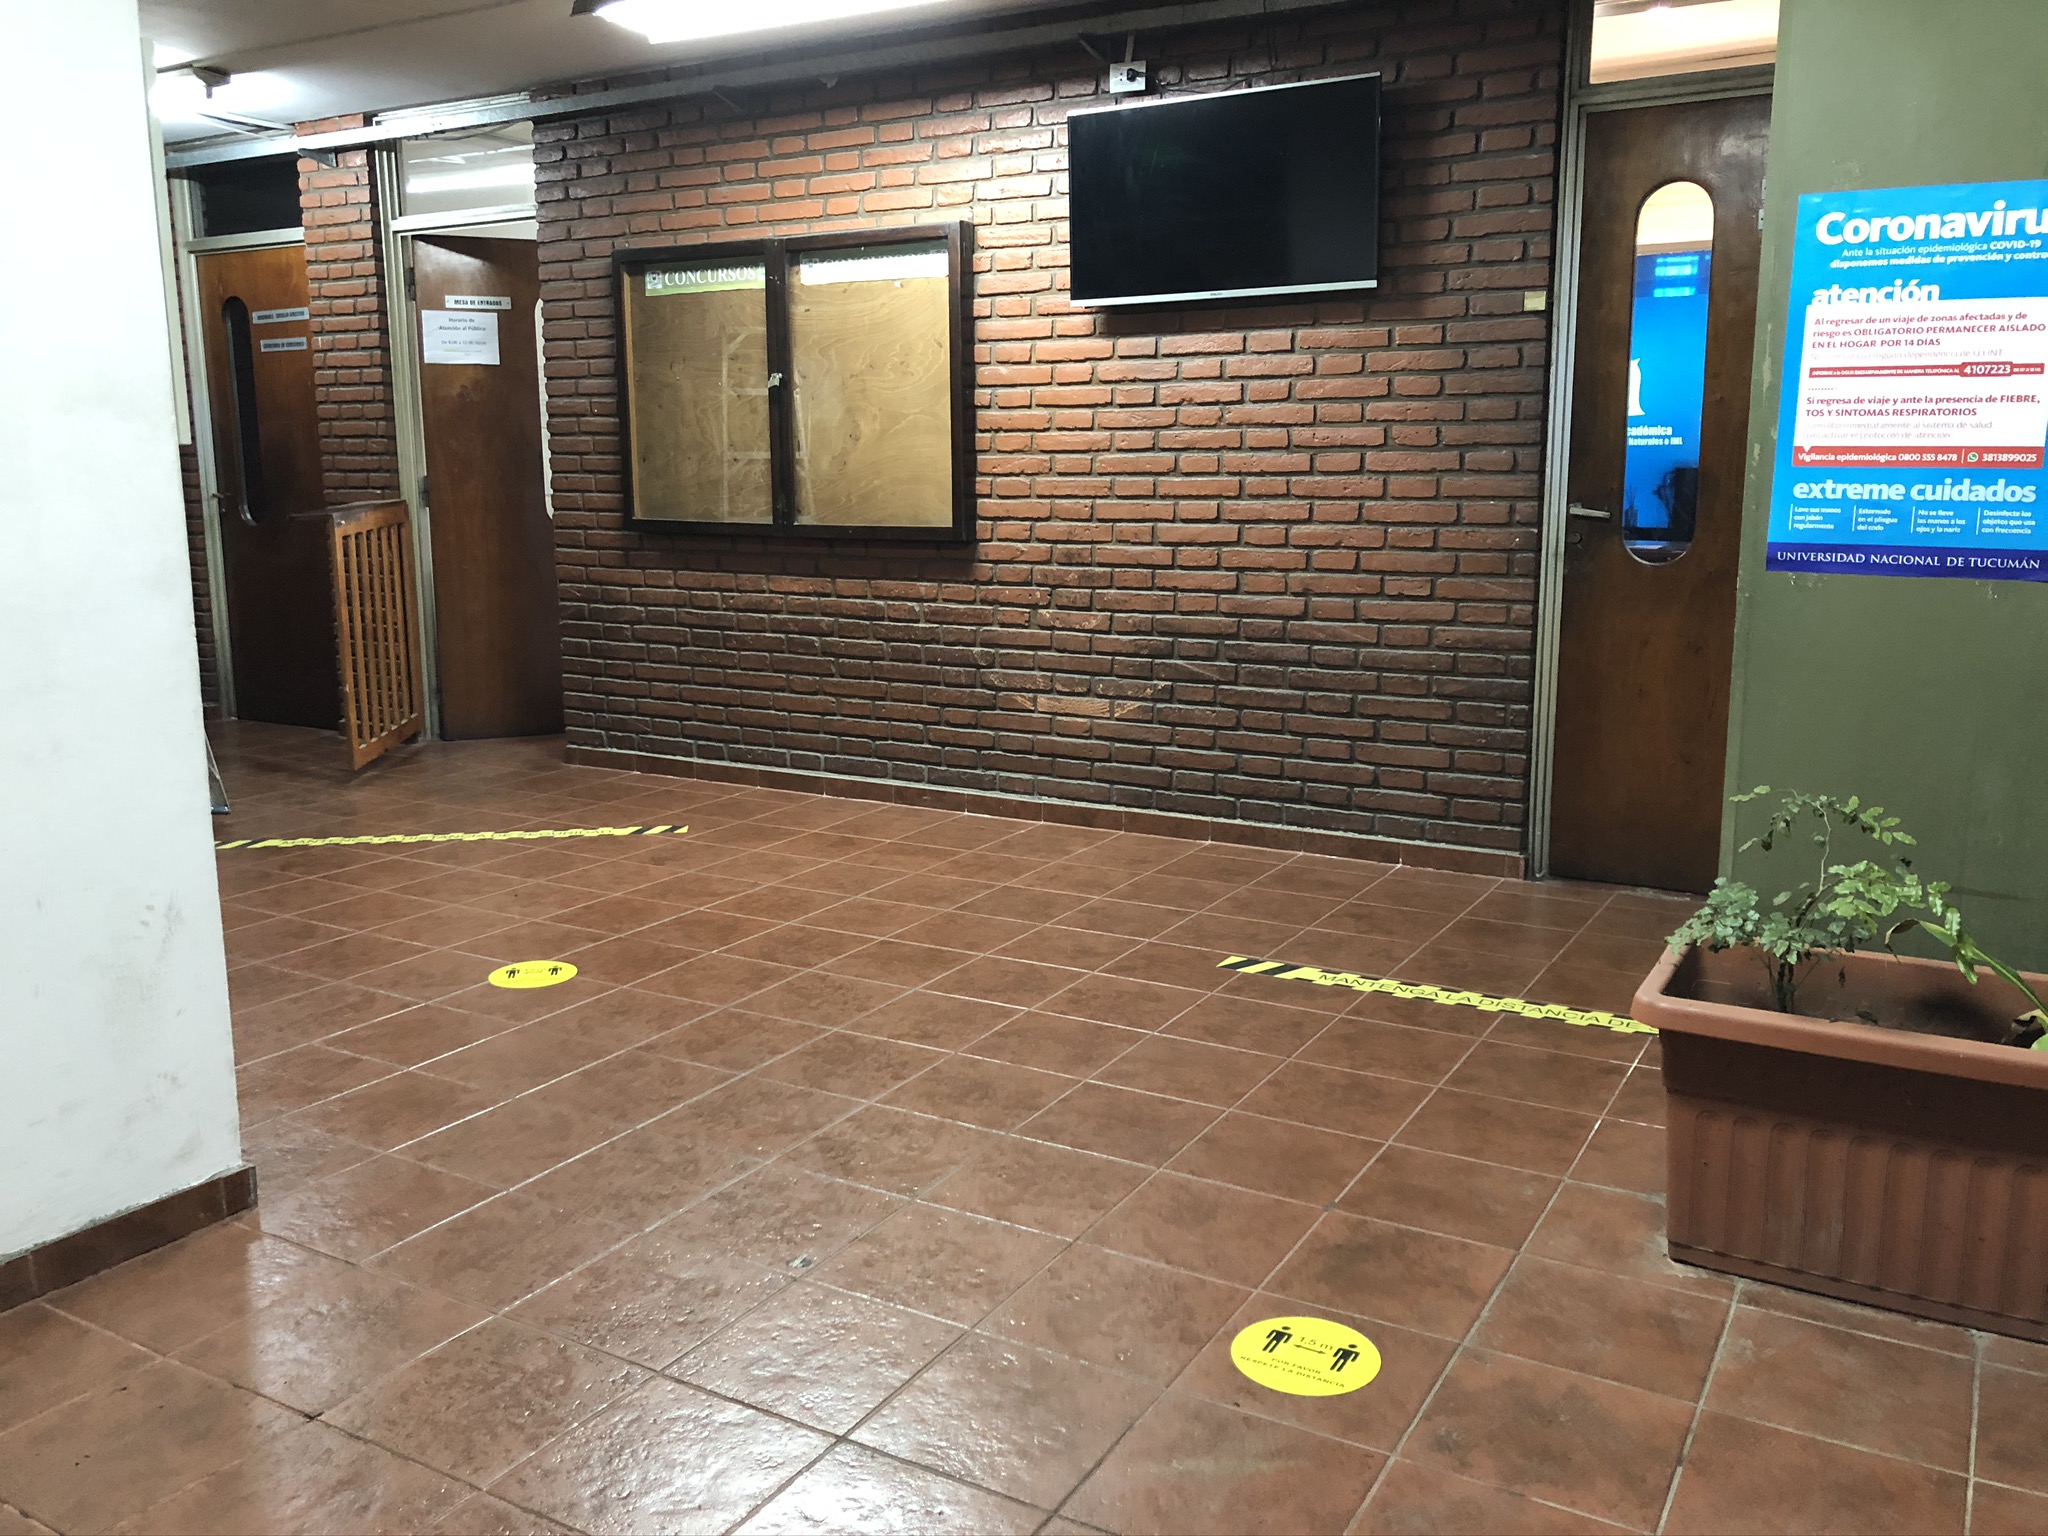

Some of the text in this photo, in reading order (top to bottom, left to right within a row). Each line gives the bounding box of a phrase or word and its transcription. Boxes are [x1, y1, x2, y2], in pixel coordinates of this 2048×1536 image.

[1842, 240, 2042, 257] Ante la situación epidemiológica COVID-19
[1830, 259, 1888, 269] disponemos
[1890, 255, 1931, 265] medidas
[1932, 255, 1945, 263] de
[1946, 252, 2004, 265] prevención
[2004, 253, 2012, 263] y
[665, 265, 757, 286] CONCURSOS
[1812, 278, 1941, 304] atención
[1826, 318, 1864, 327] regresar
[1865, 316, 1877, 324] de
[1893, 315, 1915, 325] viaje
[1917, 315, 1928, 323] de
[1959, 313, 2006, 321] afectadas
[2007, 314, 2013, 322] y
[2015, 312, 2028, 320] de
[1813, 330, 1840, 339] riesgo
[1854, 327, 1924, 336] OBLIGATORIO
[1926, 325, 1996, 334] PERMANECER
[1998, 324, 2046, 332] AISLADO
[1839, 340, 1877, 348] HOGAR
[1880, 339, 1902, 347] POR
[1916, 337, 1941, 346] DÍAS
[1963, 364, 2011, 374] 4107223
[1806, 394, 2040, 407] Si regresa de viaje y ante la presencia de FIEBRE,
[1806, 409, 1825, 417] TOS
[1835, 408, 1890, 417] SÍNTOMAS
[1892, 408, 1977, 416] RESPIRATORIOS
[1798, 452, 2037, 463] Vigilancia epidemiológica 0800 555 8478 3813899025
[1793, 477, 2037, 503] extreme cuidados
[1983, 509, 2020, 517] Desinfecte
[1995, 526, 2031, 534] frecuencia
[1777, 551, 2040, 569] UNIVERSIDAD NACIONAL DE TUCUMÁN
[1318, 974, 1641, 1030] MANTENGA LA DISTANCIA DE
[1240, 1356, 1279, 1369] RESPETE
[1296, 1371, 1345, 1388] DISTANCIA
[1272, 1357, 1321, 1375] POR FAVOR
